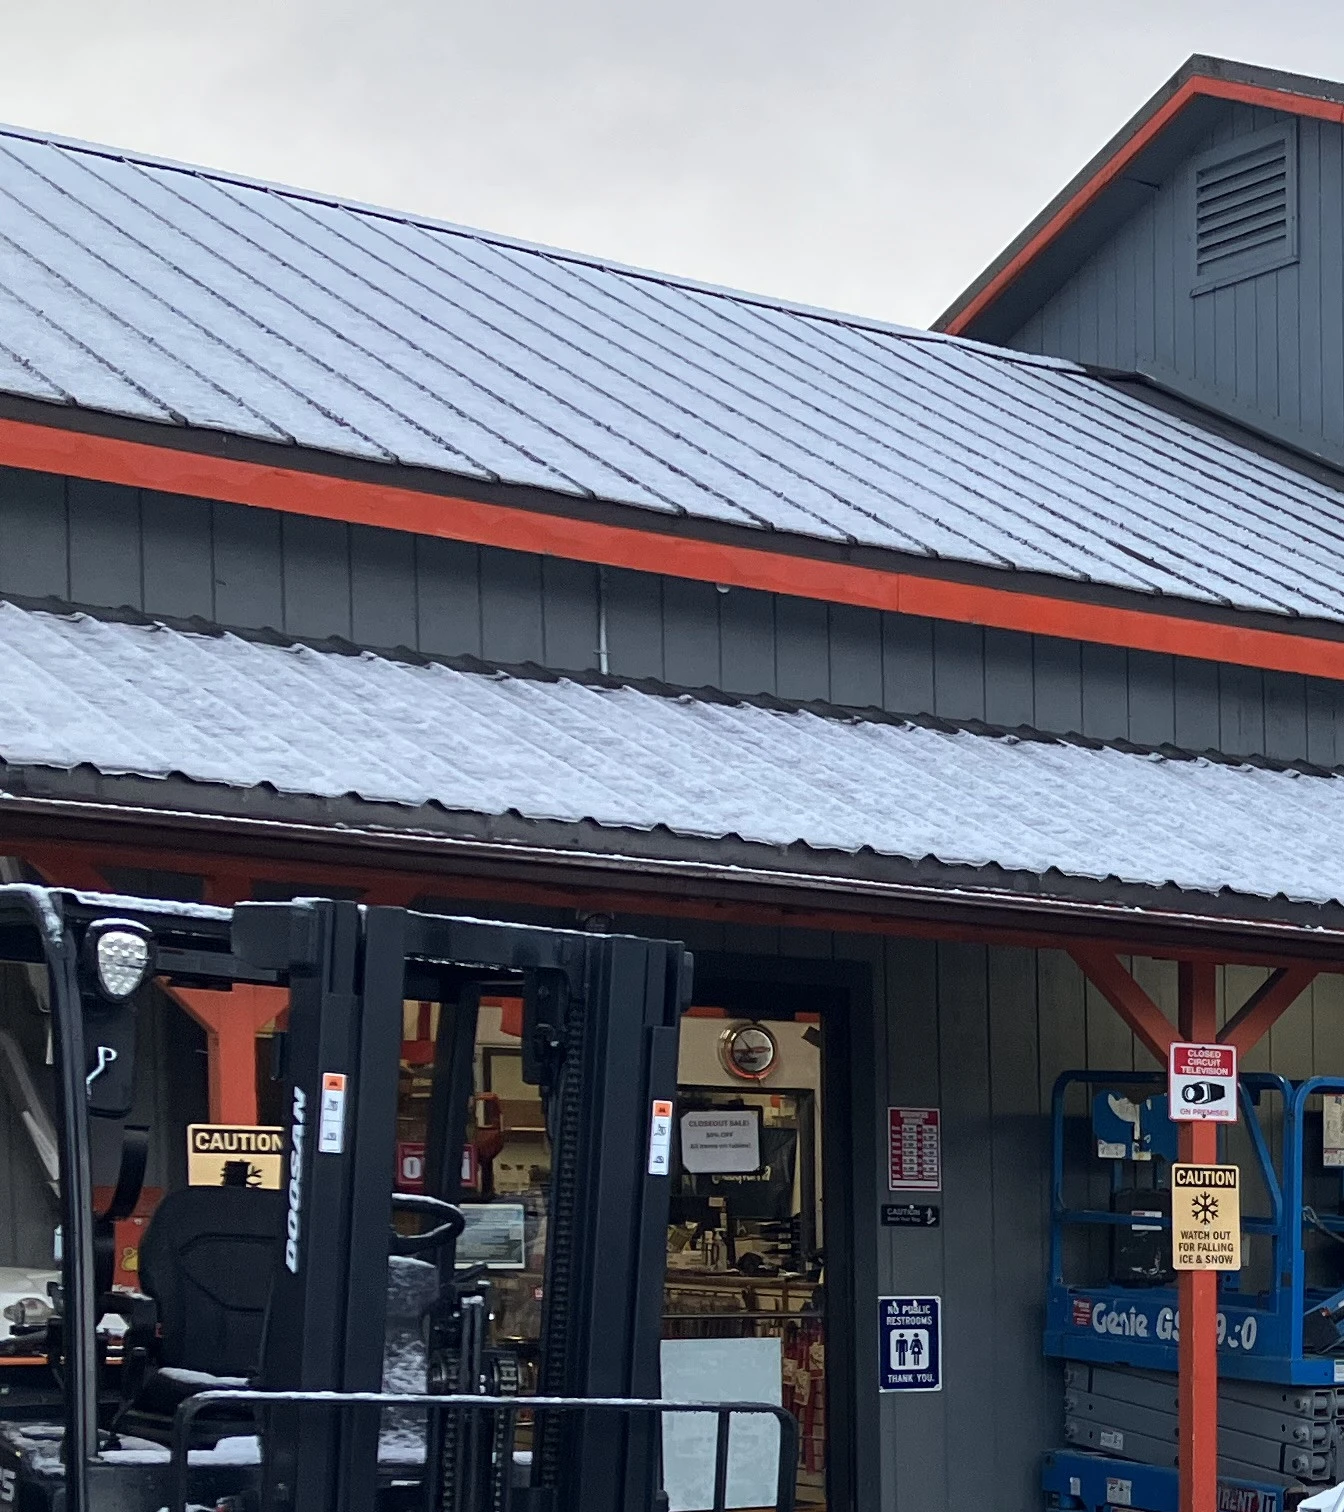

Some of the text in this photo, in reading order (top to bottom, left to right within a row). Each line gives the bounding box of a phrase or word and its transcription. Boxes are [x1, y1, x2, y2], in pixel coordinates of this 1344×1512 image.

[1188, 1050, 1221, 1058] CLOSED
[1187, 1058, 1221, 1066] CIRCUIT
[1181, 1066, 1228, 1075] TELEVISION
[195, 1132, 284, 1151] CAUTION
[285, 1086, 306, 1274] DOOSAN
[1177, 1170, 1234, 1186] CAUTION
[887, 1208, 920, 1216] CAUTION
[1181, 1231, 1231, 1240] WATCH OUT
[1179, 1243, 1233, 1252] FOR FALLING
[1180, 1255, 1233, 1264] ICE & SNOW
[887, 1304, 931, 1315] NO PUBLIC
[886, 1316, 933, 1326] RESTROOMS
[1092, 1303, 1149, 1337] Genie
[888, 1374, 913, 1384] THANK
